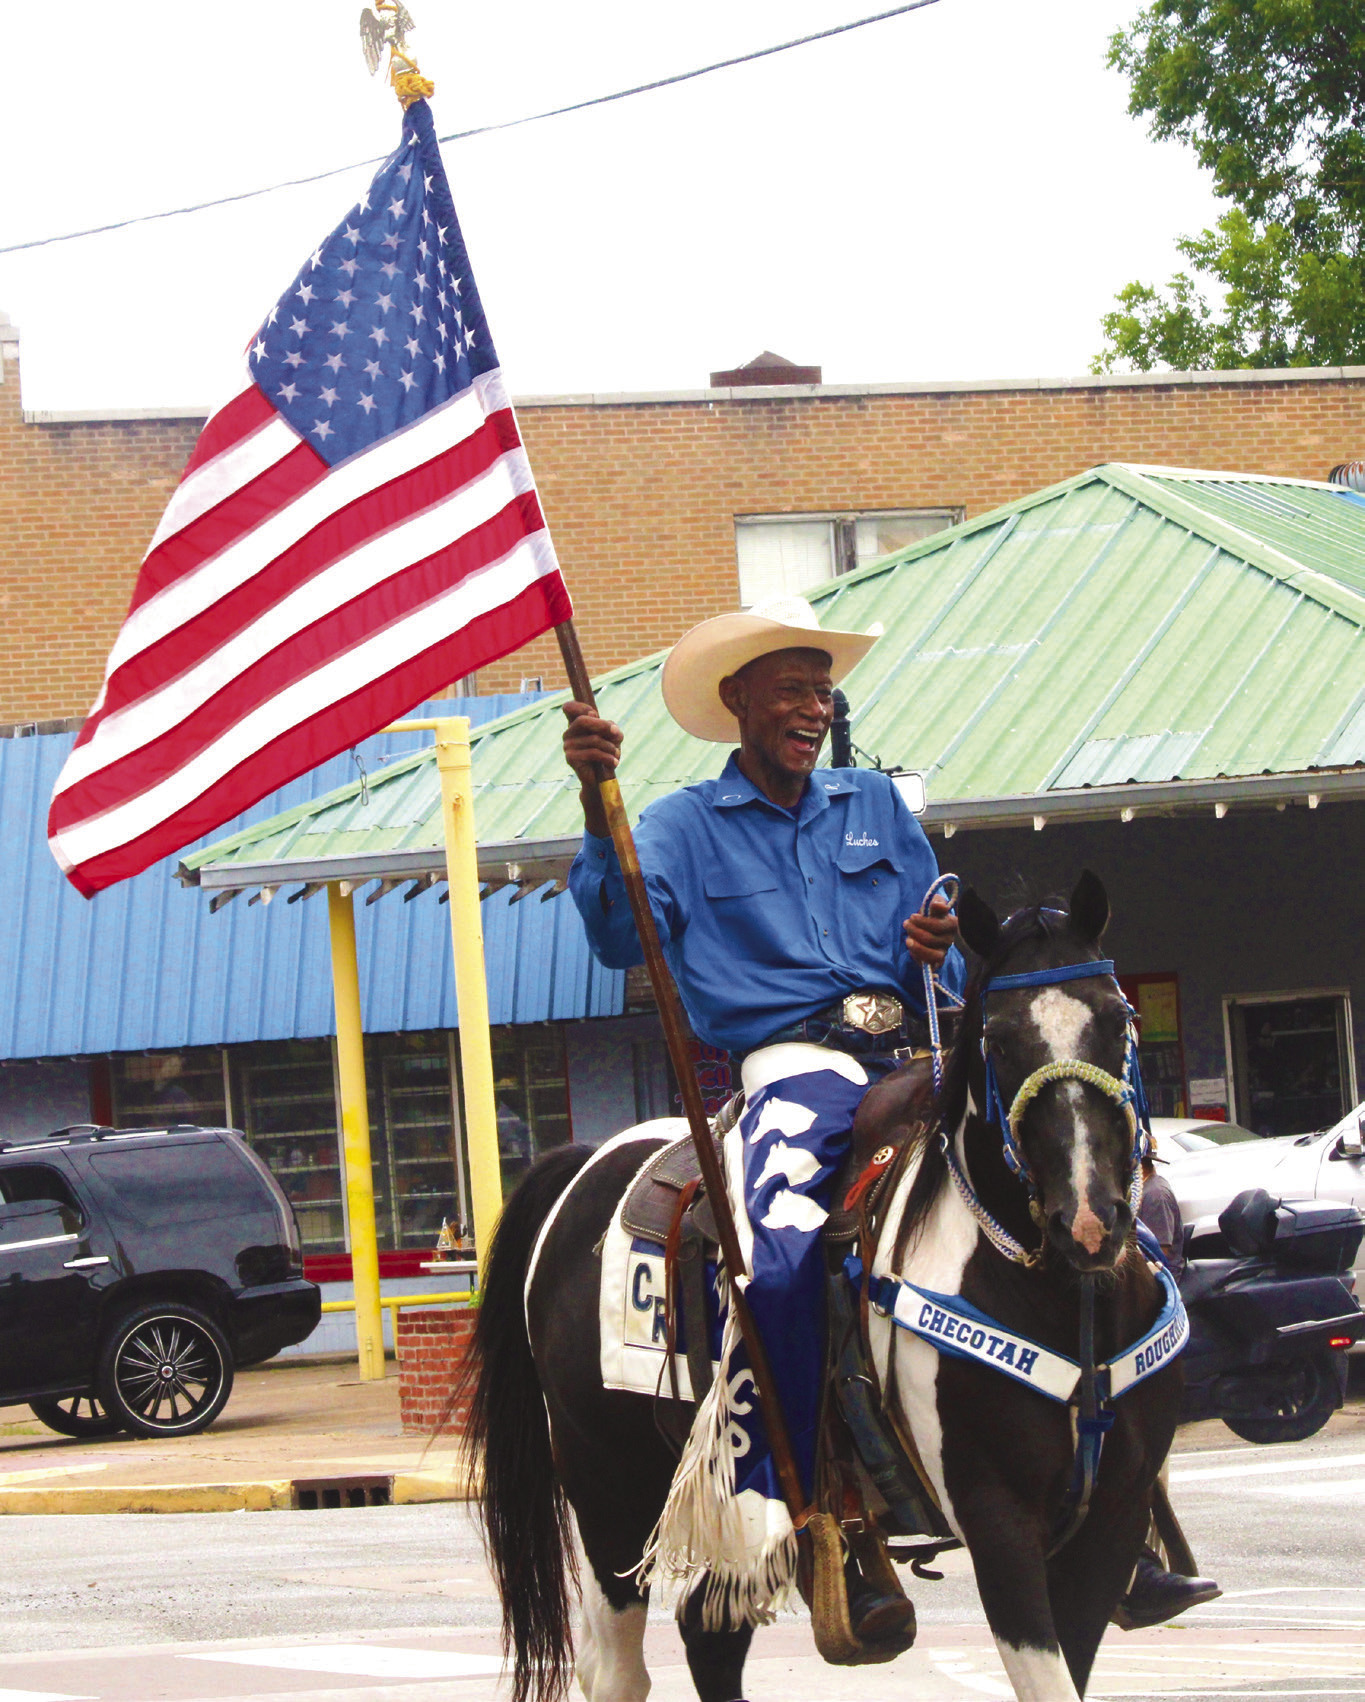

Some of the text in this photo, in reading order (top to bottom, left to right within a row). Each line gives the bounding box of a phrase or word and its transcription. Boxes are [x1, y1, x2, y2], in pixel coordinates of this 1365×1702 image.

[845, 831, 880, 847] Luches
[697, 1064, 732, 1089] ell
[918, 1303, 1040, 1376] CHECOTAH
